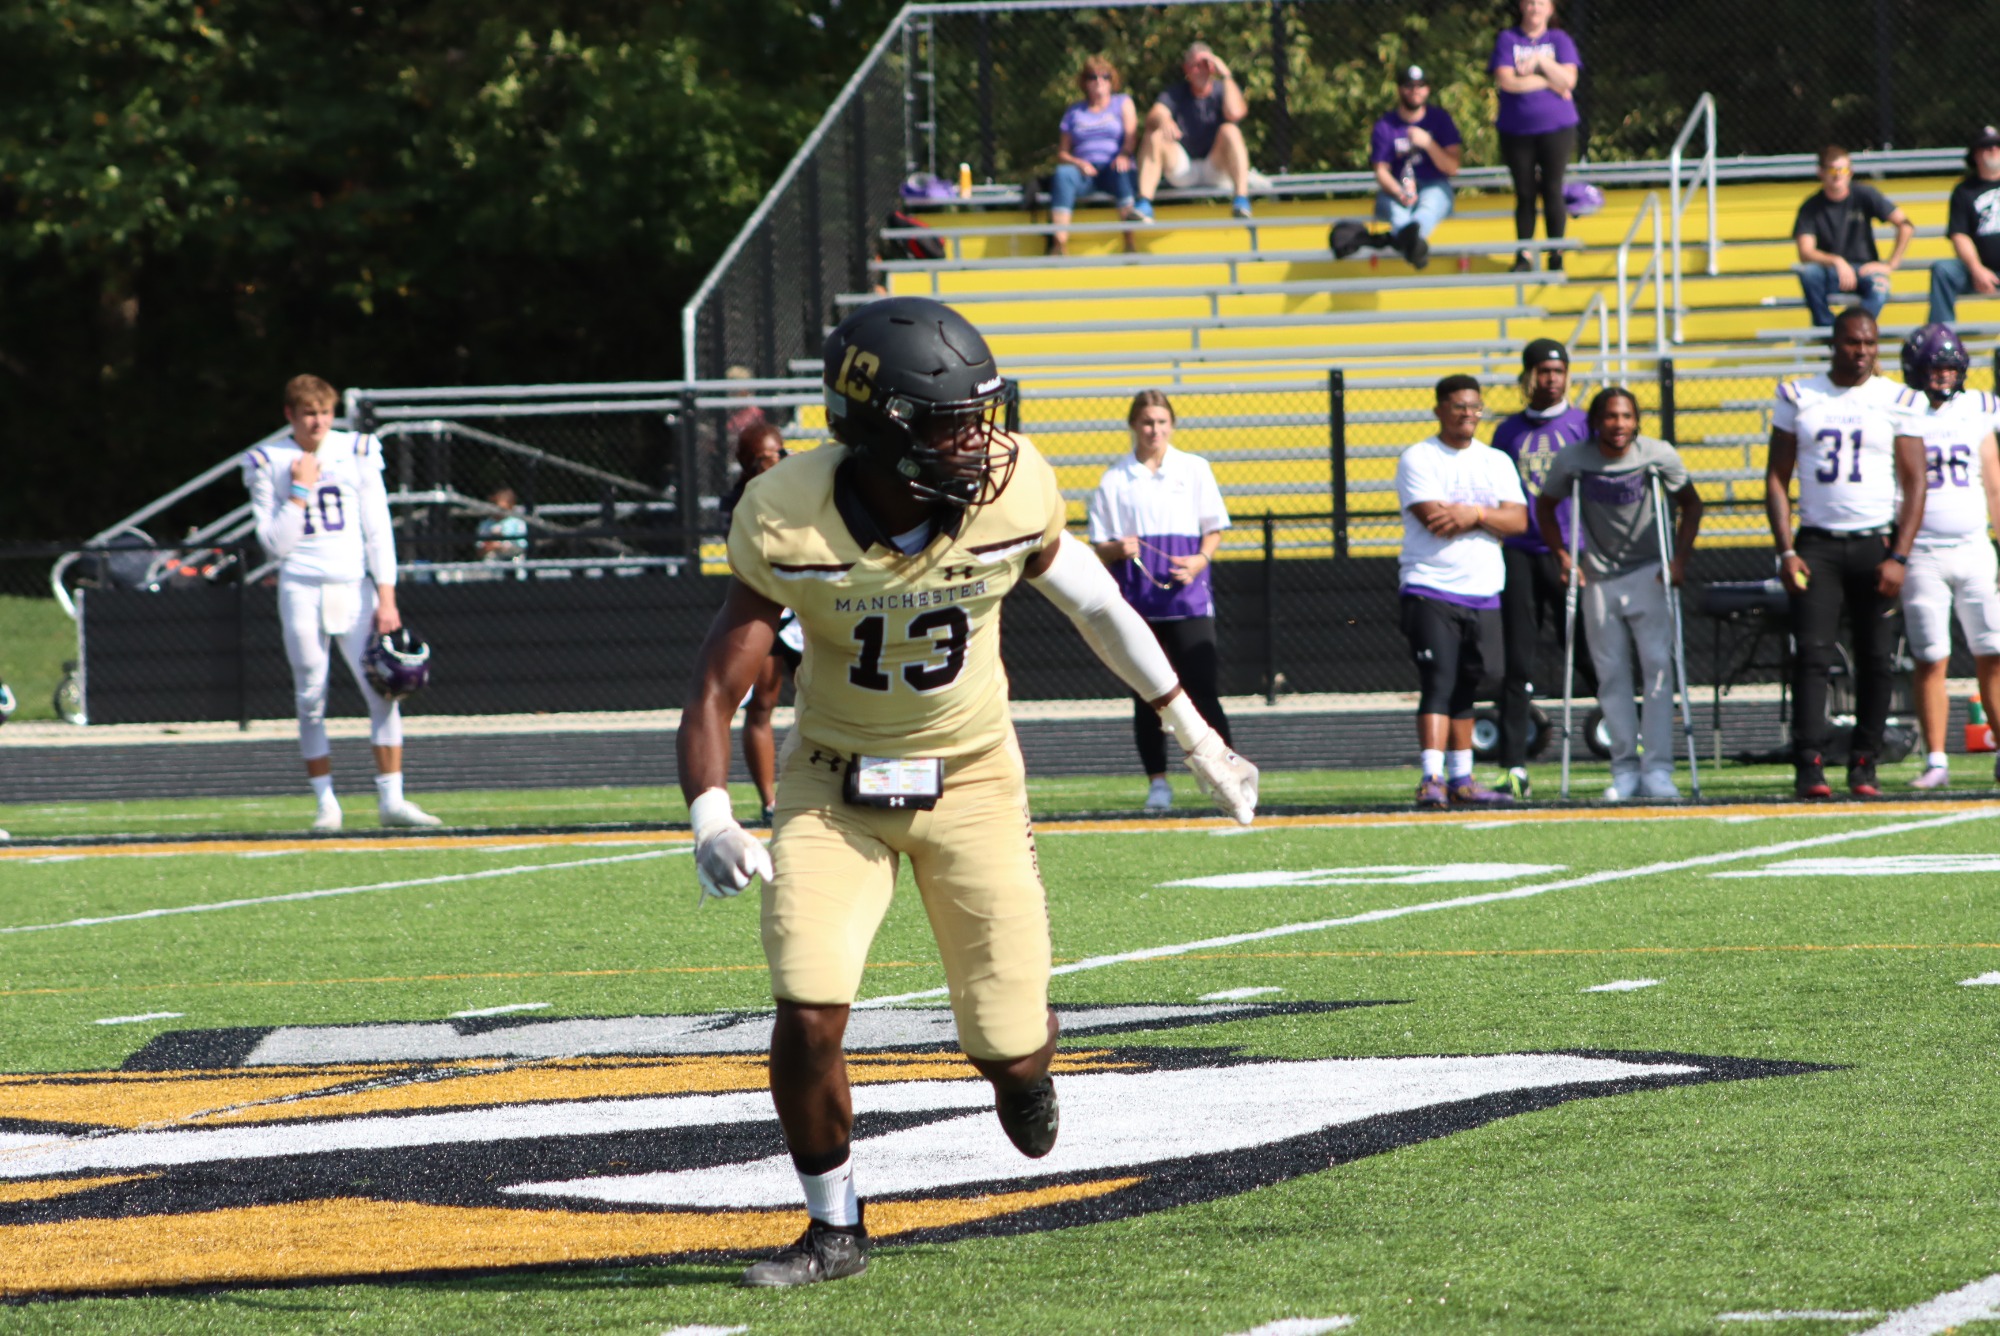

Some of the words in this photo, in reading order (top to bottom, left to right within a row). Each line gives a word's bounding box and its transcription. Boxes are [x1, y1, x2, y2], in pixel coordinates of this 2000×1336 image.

[836, 344, 880, 402] 13
[1815, 428, 1862, 483] 31
[835, 581, 988, 612] MANCHESTER
[848, 605, 973, 694] 13
